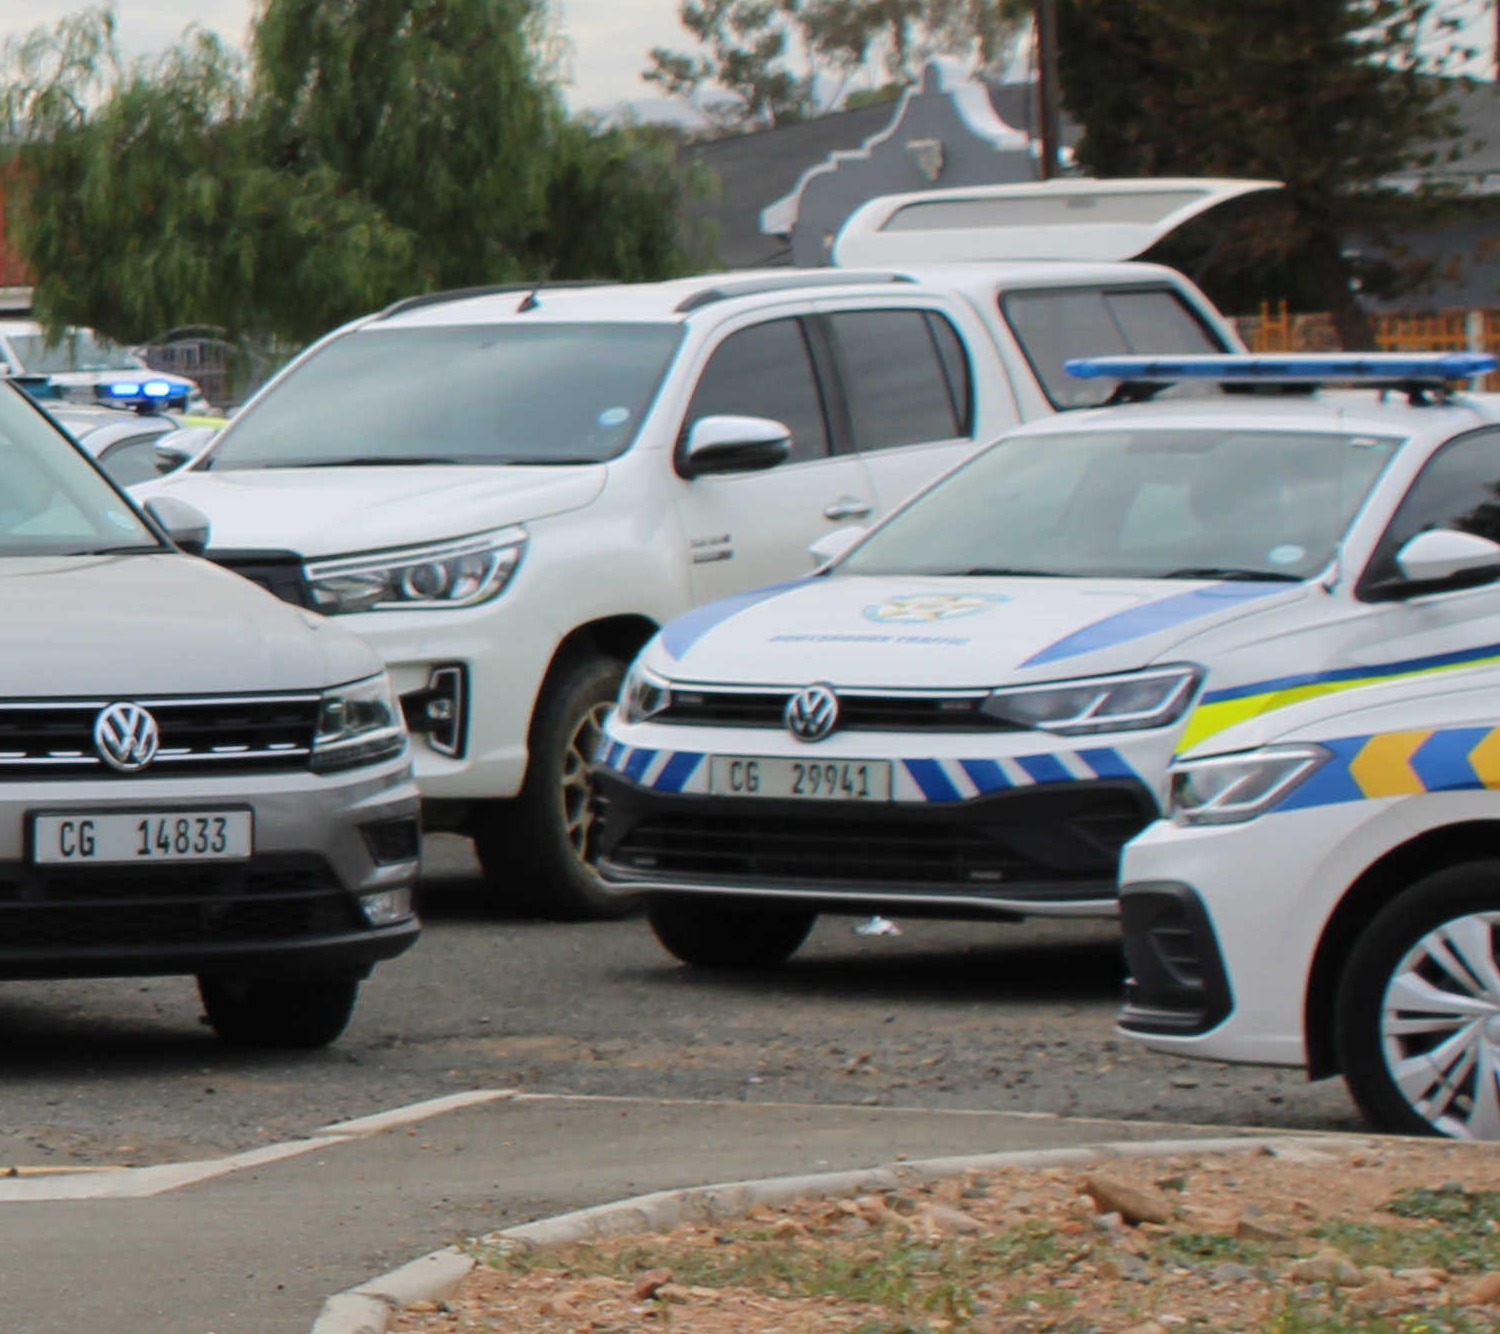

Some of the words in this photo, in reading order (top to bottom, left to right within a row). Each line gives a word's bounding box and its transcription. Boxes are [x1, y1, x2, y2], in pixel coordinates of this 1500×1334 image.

[729, 760, 760, 793] CG
[791, 762, 870, 798] 29941
[59, 819, 96, 857] CG
[136, 816, 228, 856] 14833
